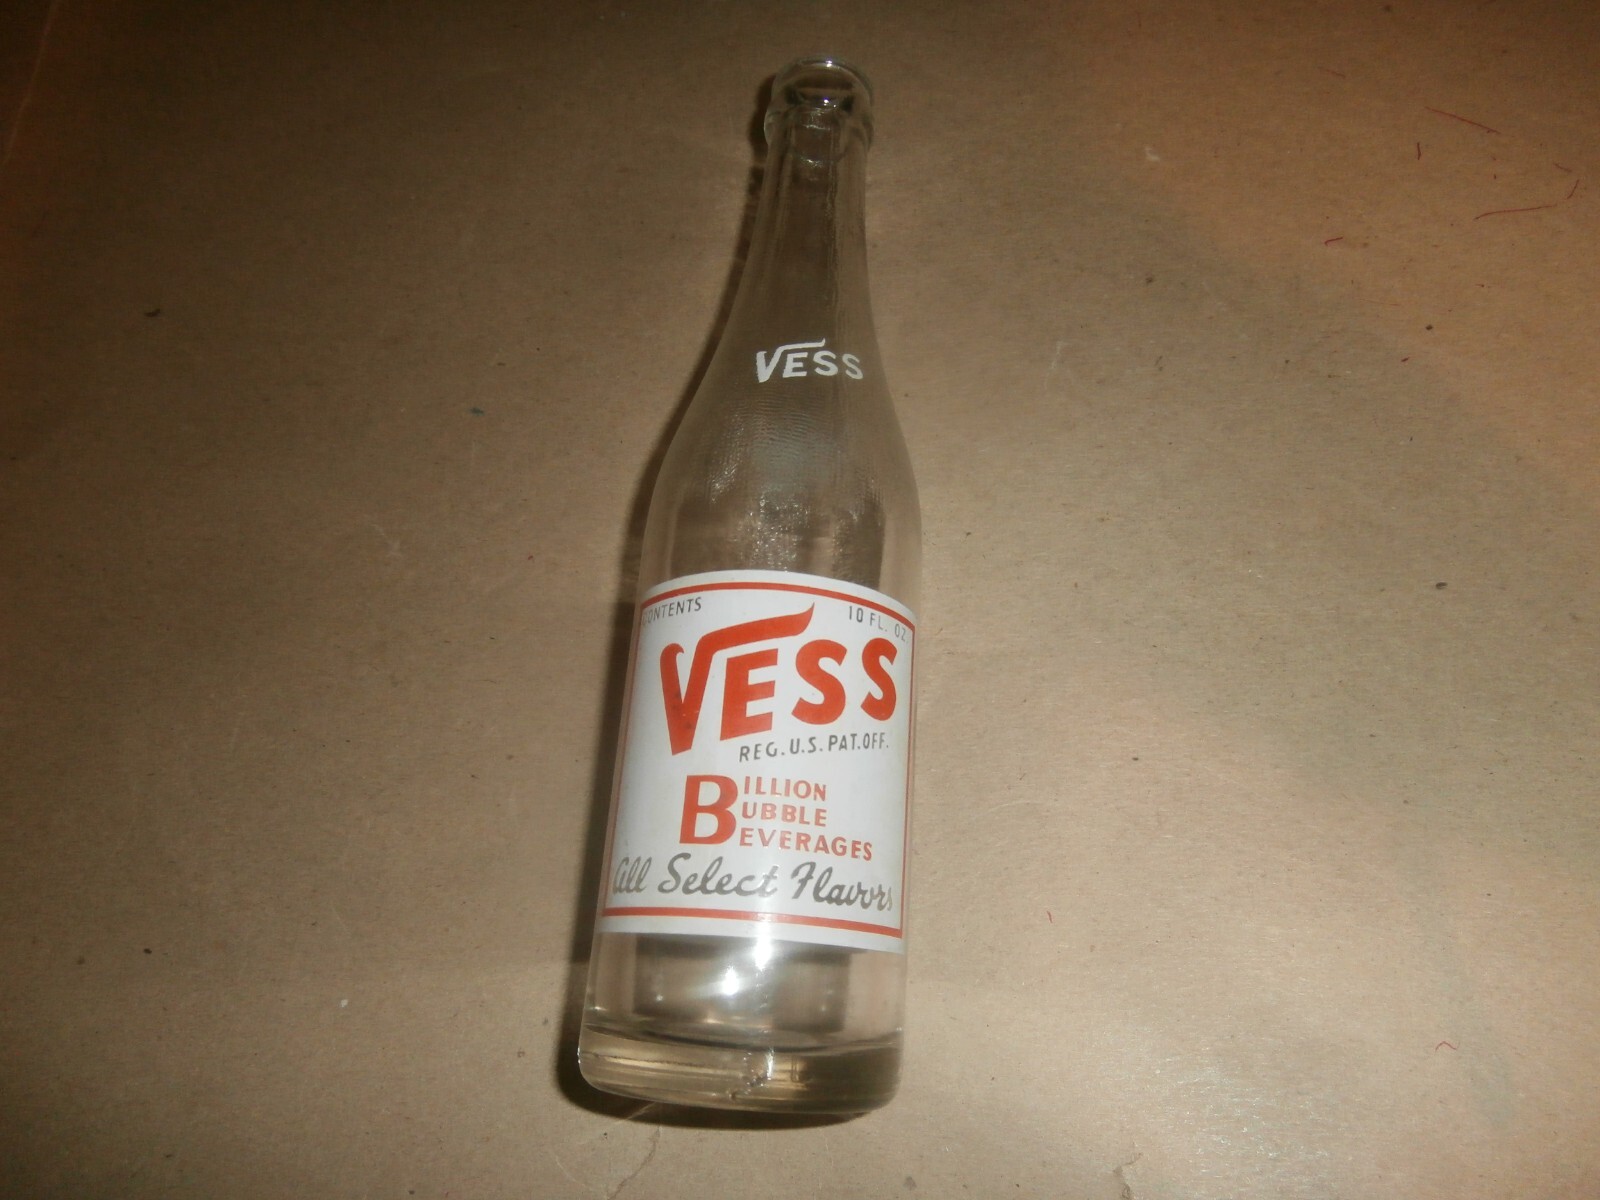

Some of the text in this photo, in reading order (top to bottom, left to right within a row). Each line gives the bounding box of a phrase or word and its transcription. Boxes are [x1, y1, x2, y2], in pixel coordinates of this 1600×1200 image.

[756, 338, 864, 383] VESS
[849, 606, 864, 623] 10
[660, 601, 898, 756] VESS
[612, 852, 893, 911] All Select Flavors
